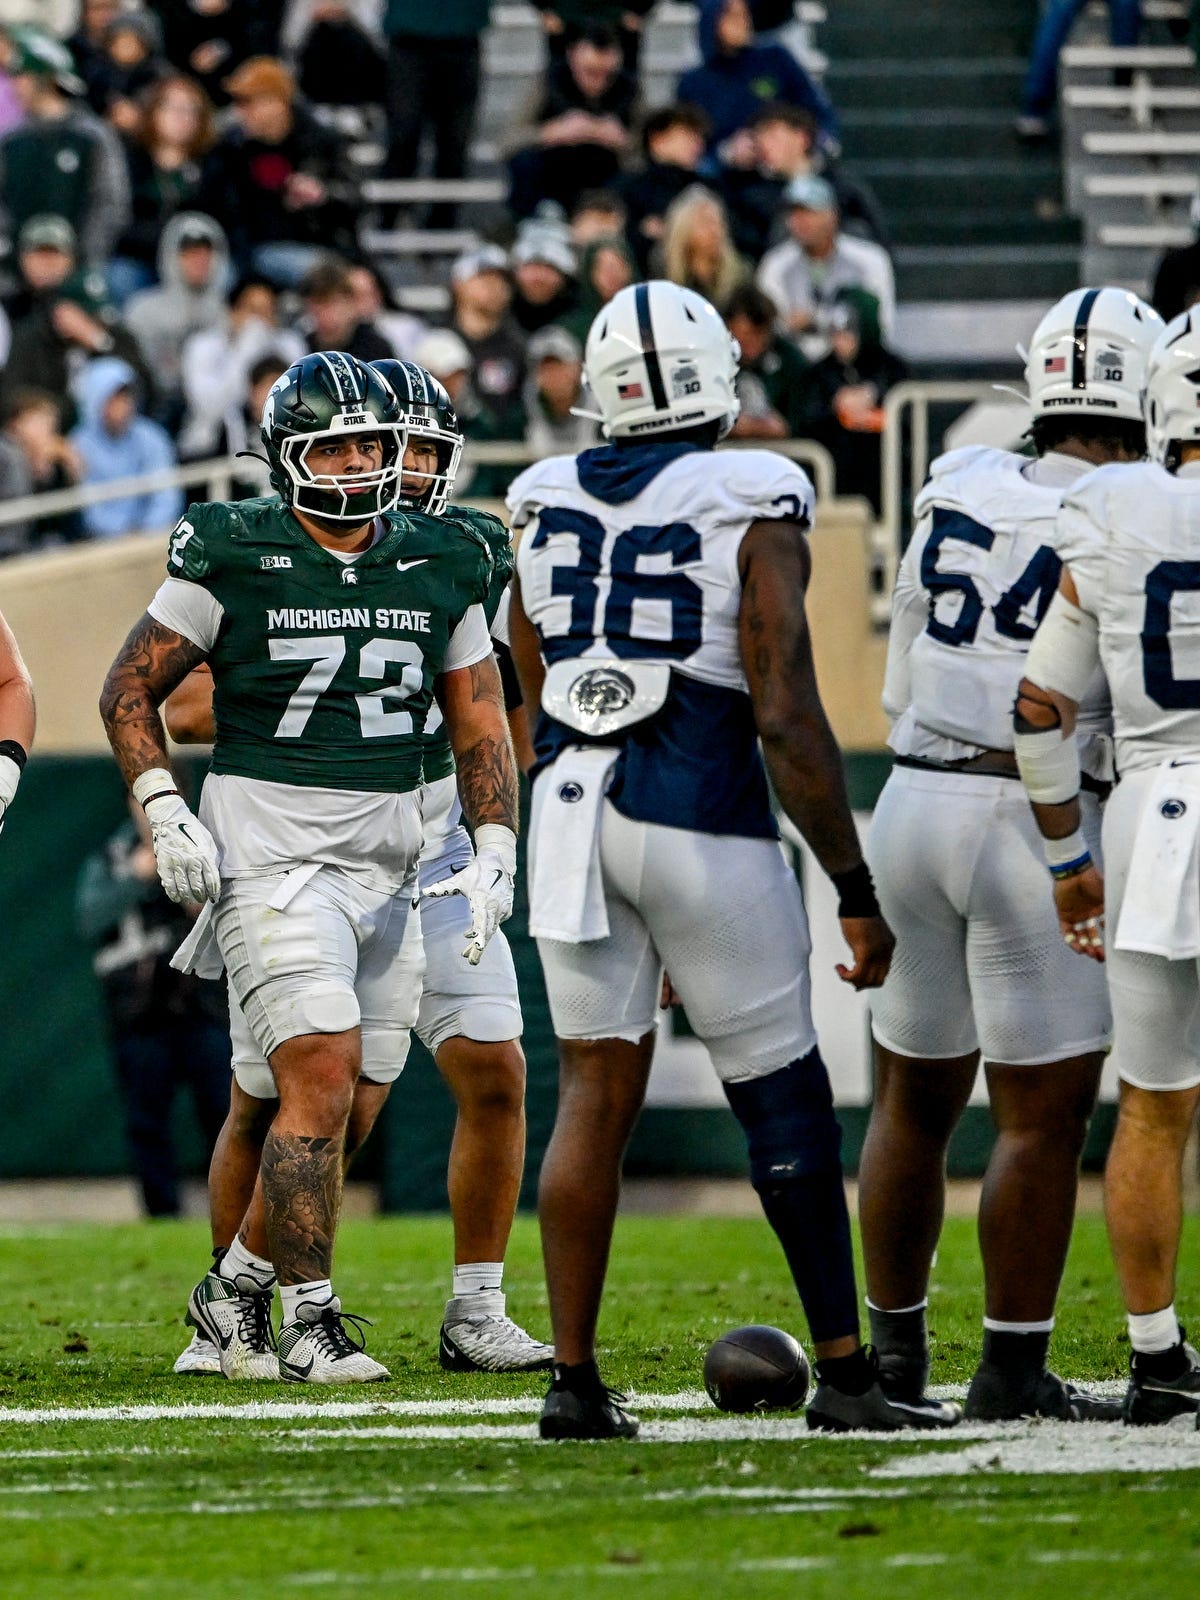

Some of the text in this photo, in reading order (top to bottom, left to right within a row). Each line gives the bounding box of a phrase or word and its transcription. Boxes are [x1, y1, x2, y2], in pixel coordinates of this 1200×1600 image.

[343, 415, 367, 426] STATE
[408, 416, 431, 427] STATE
[168, 515, 195, 568] 2
[530, 506, 704, 663] 36
[920, 506, 1064, 647] 64
[265, 607, 432, 634] MICHIGAN STATE
[267, 635, 425, 738] 72
